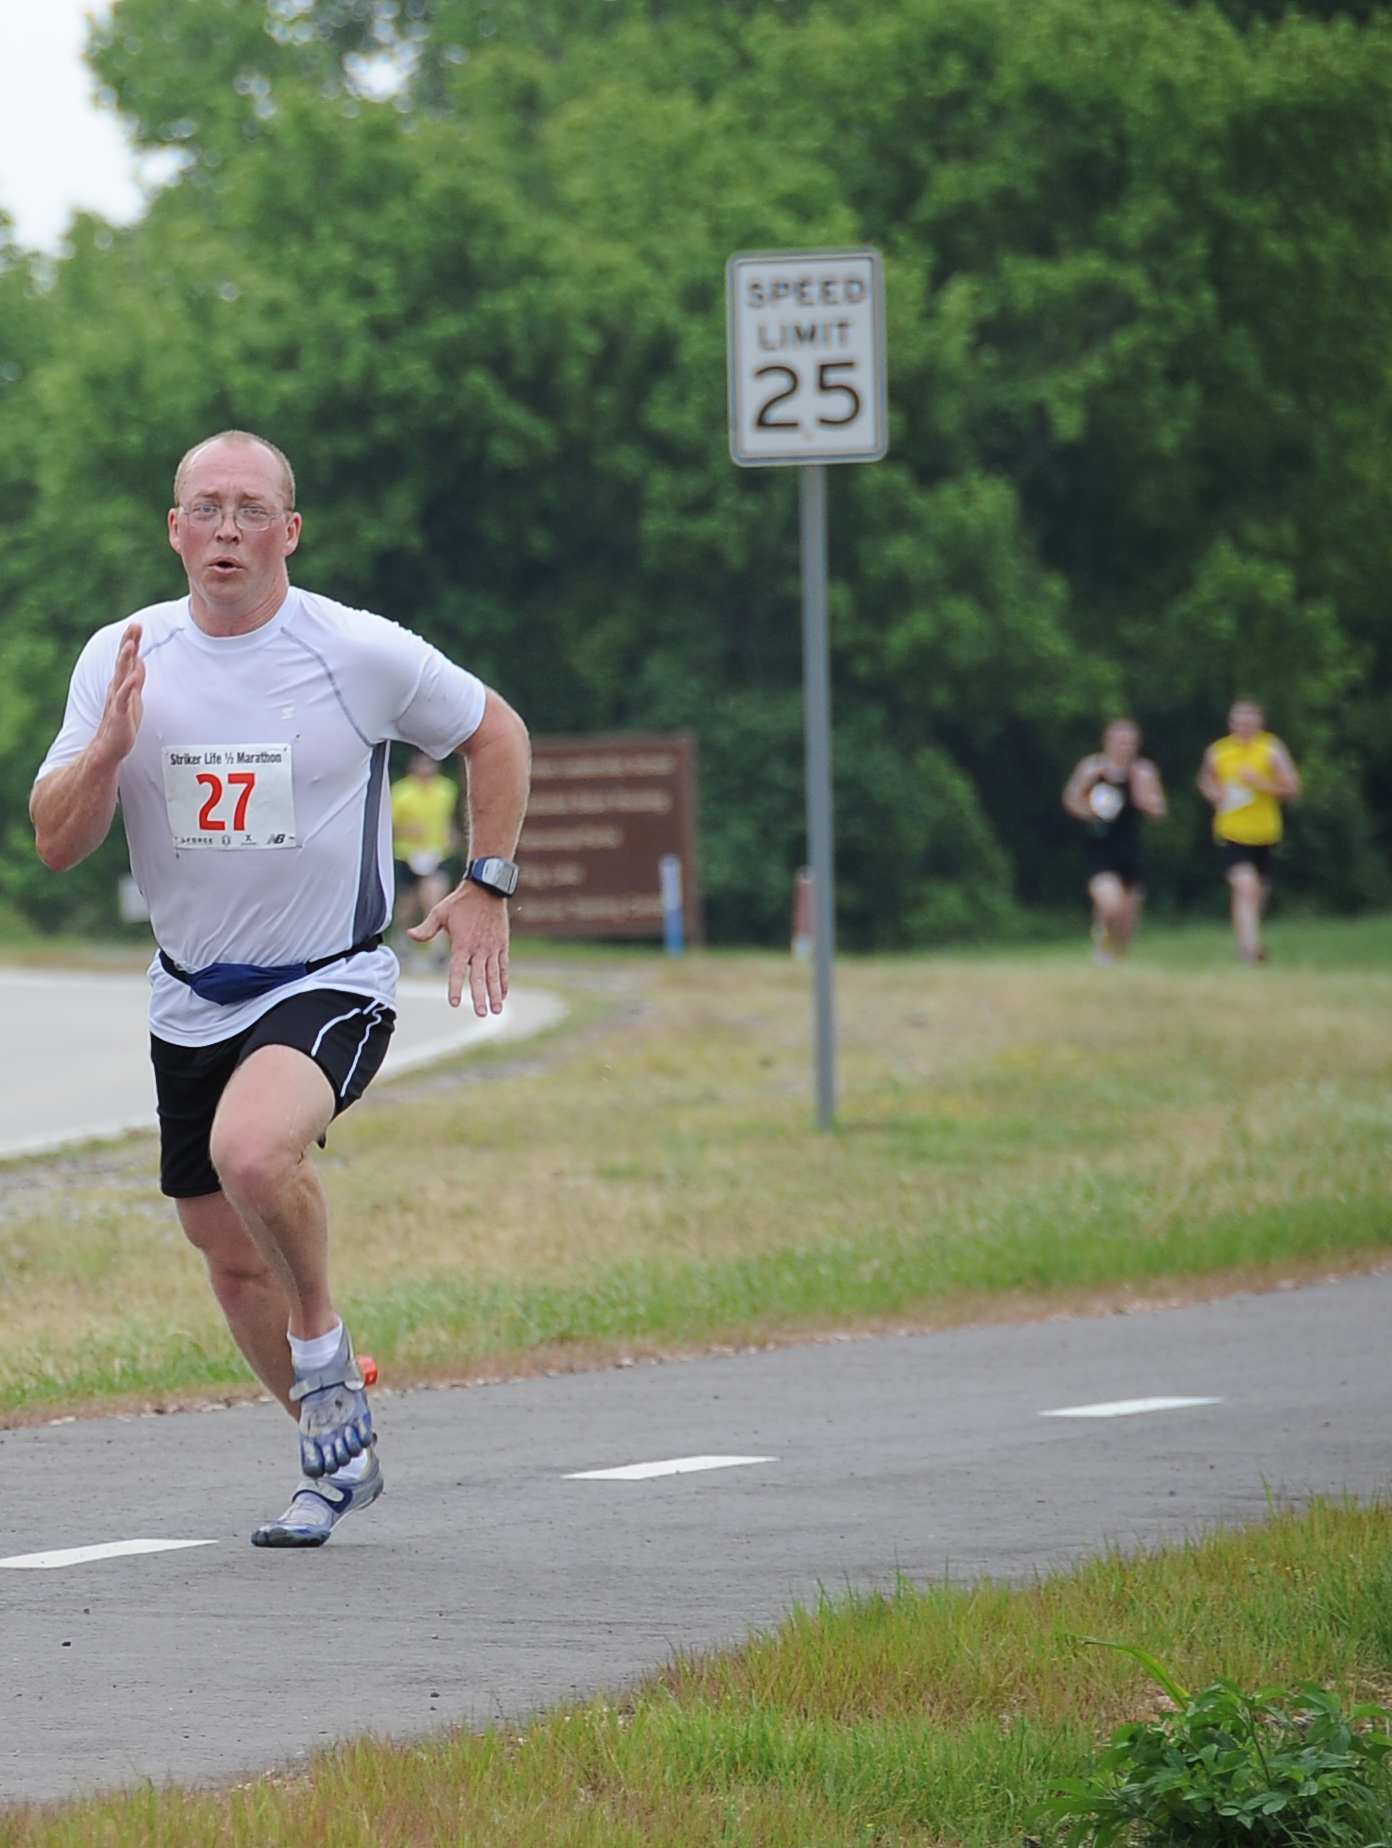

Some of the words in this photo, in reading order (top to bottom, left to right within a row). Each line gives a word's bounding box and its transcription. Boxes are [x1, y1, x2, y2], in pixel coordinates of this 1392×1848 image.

[747, 276, 867, 308] SPEED
[758, 319, 852, 350] LIMIT
[755, 360, 861, 428] 25
[170, 753, 201, 765] Striker
[204, 752, 222, 765] Life
[236, 751, 282, 764] Marathon
[196, 772, 256, 832] 27
